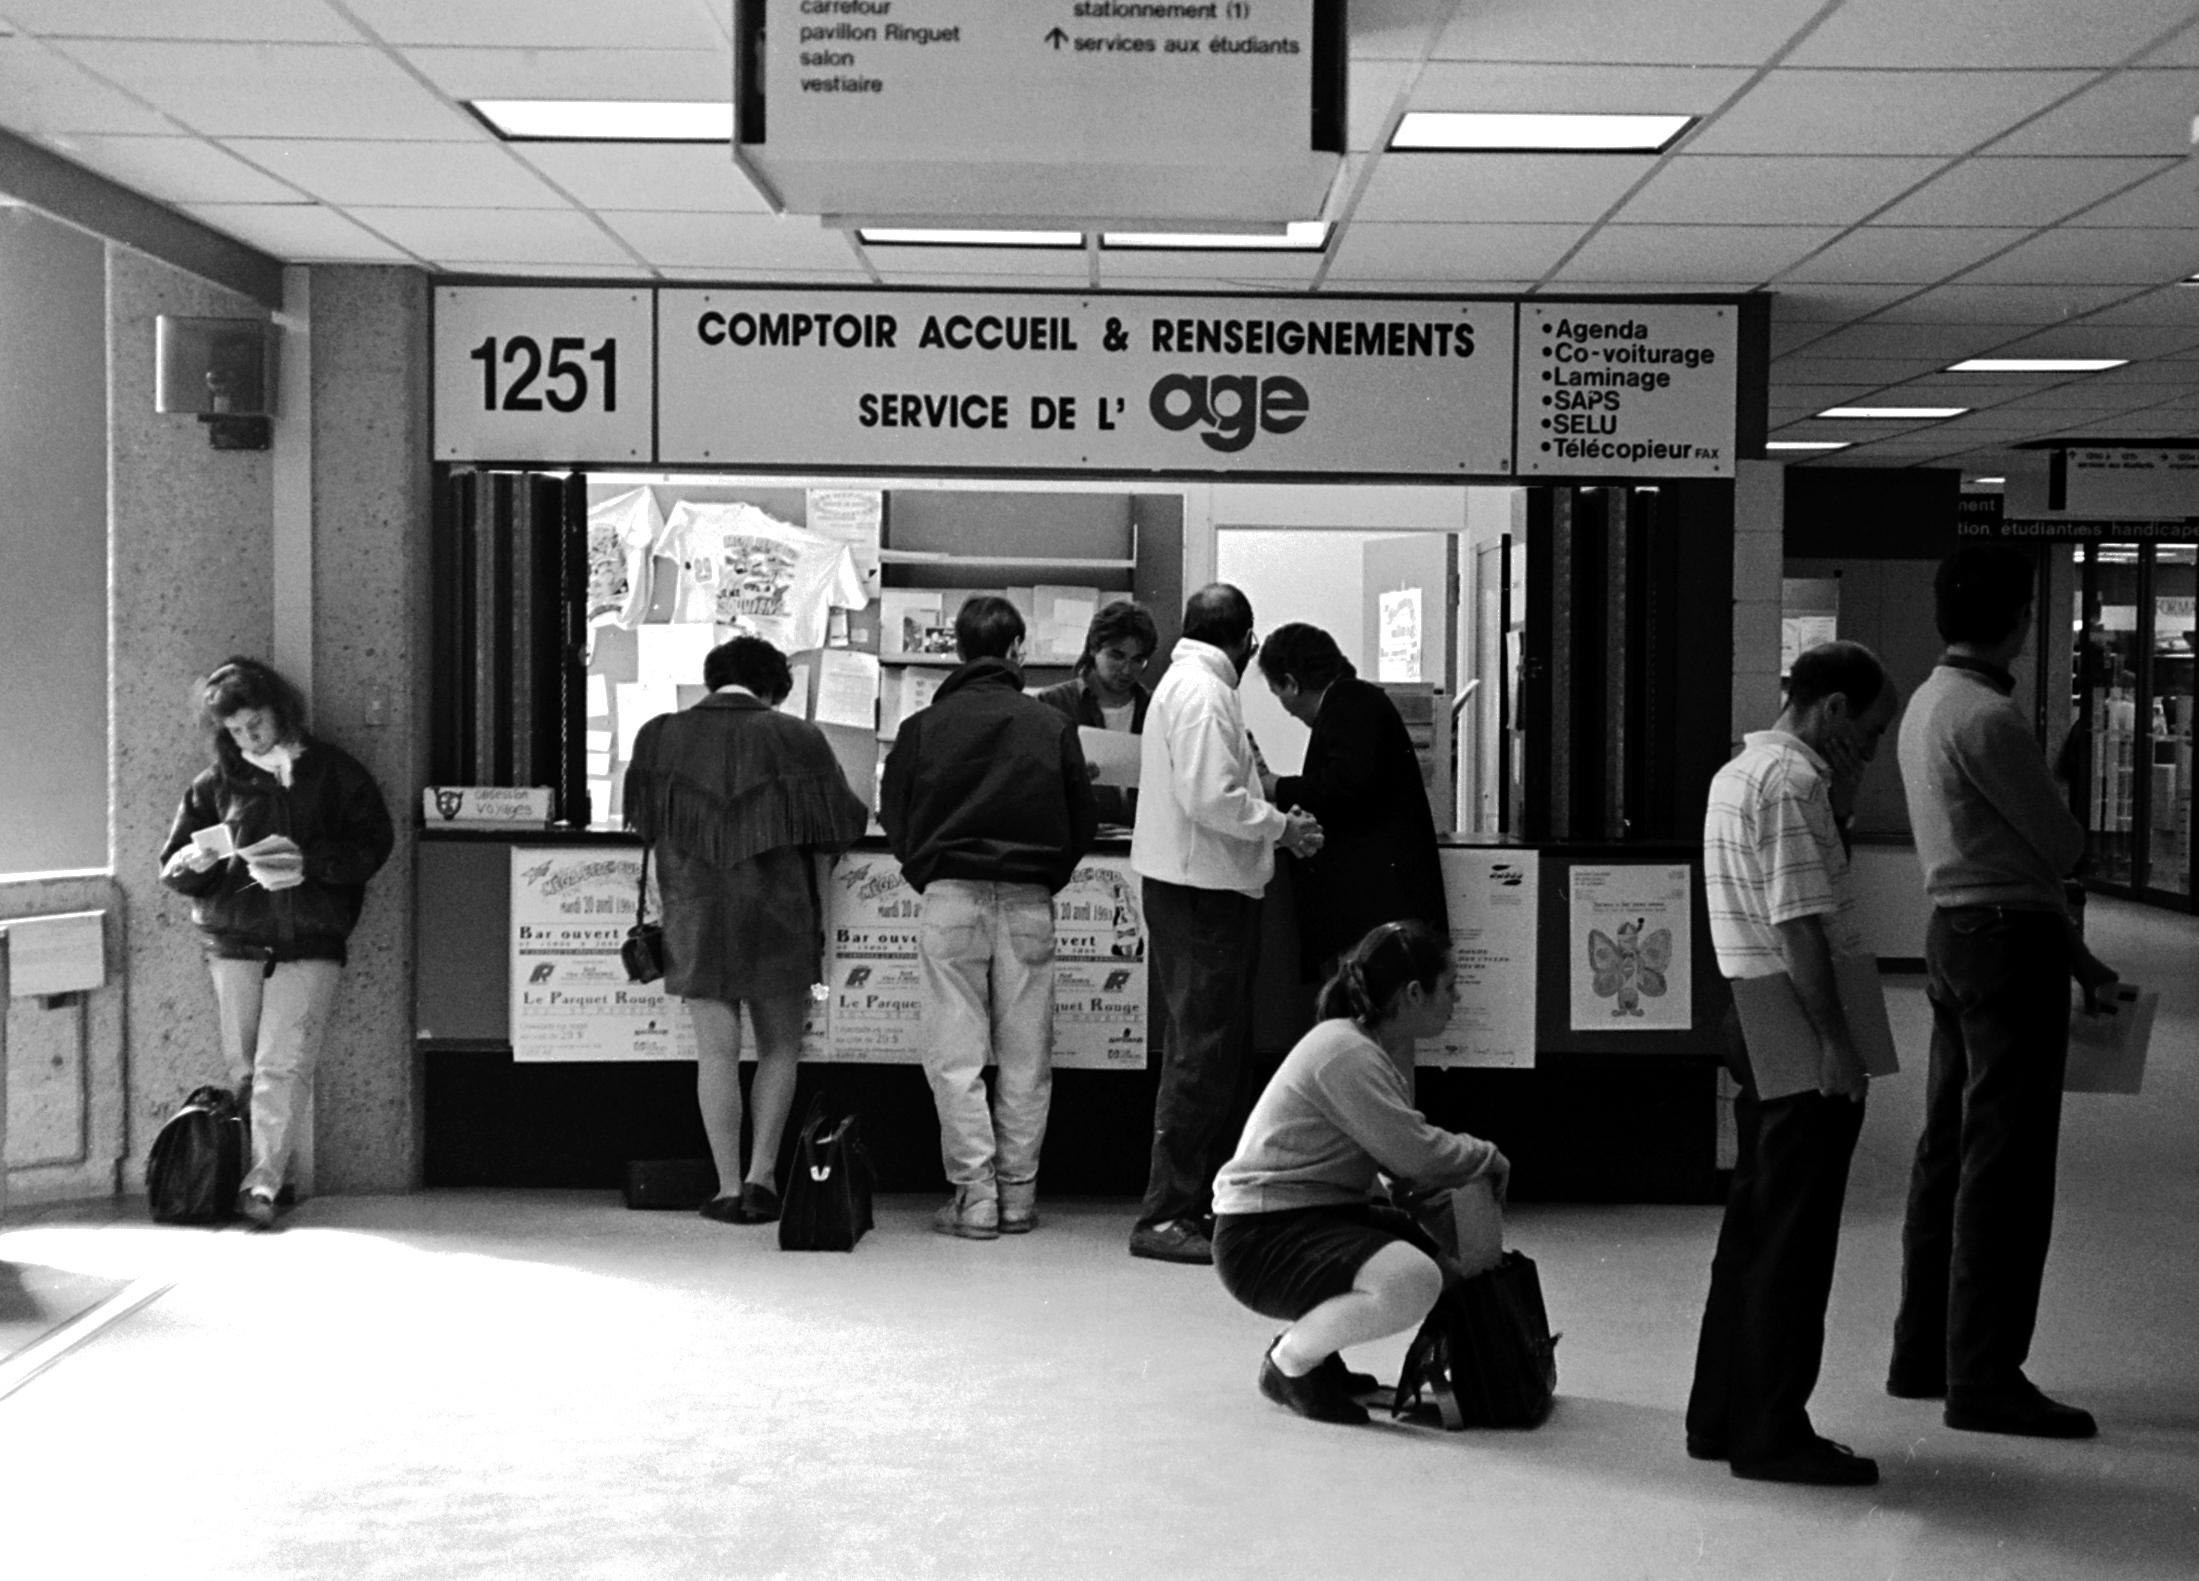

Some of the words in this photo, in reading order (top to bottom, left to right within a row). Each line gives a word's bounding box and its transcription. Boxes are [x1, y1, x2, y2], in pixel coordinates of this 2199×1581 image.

[800, 0, 892, 15] carrefour
[1073, 0, 1217, 19] stationnement
[1226, 1, 1250, 20] (1)
[800, 22, 877, 44] pavillon
[885, 22, 961, 45] Ringuet
[1073, 34, 1156, 52] services
[1163, 38, 1201, 53] aux
[1208, 35, 1300, 54] étudiants
[800, 49, 855, 66] salon
[800, 74, 884, 93] vestiaire
[697, 311, 898, 349] COMPTOIR
[918, 315, 1079, 352] ACCUEIL
[1102, 316, 1130, 353] &
[1151, 318, 1476, 359] RENSEIGNEMENTS
[1555, 318, 1649, 344] Agenda
[1554, 342, 1716, 369] Co-voiturage
[470, 335, 618, 413] 1251
[1553, 365, 1671, 392] Laminage
[1553, 389, 1621, 411] SAPS
[858, 393, 1010, 430] SERVICE
[1029, 395, 1077, 431] DE
[1098, 396, 1126, 432] L'
[1149, 372, 1311, 454] age
[1552, 413, 1618, 435] SELU
[1552, 437, 1693, 463] Télécopieur
[1694, 447, 1720, 460] FAX
[519, 925, 552, 940] Bar
[560, 926, 621, 940] ouvert
[836, 928, 870, 943] Bar
[523, 990, 544, 1005] Le
[549, 990, 609, 1007] Parquet
[614, 990, 665, 1008] Rouge
[839, 994, 860, 1009] Le
[1090, 997, 1141, 1015] Rouge
